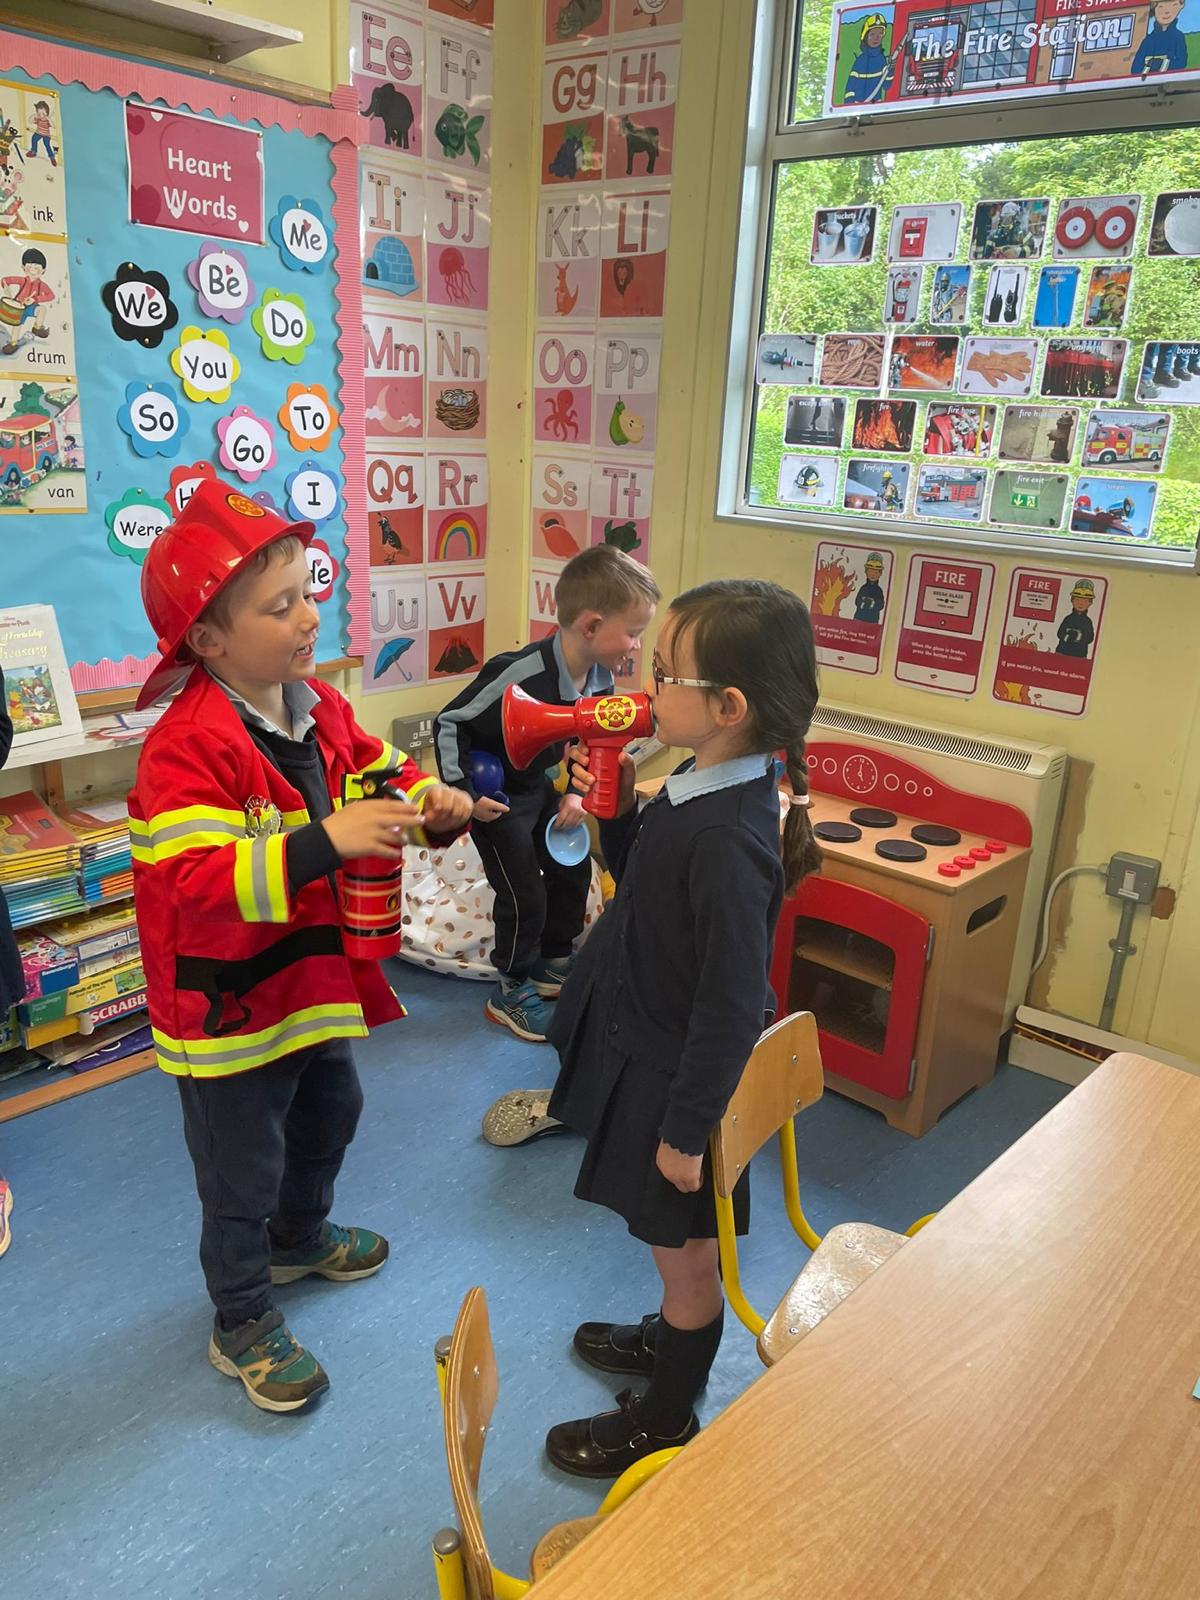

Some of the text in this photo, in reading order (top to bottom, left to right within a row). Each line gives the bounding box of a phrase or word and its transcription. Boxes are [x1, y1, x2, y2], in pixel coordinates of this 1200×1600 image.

[362, 11, 413, 80] Ee
[912, 14, 1121, 62] The Fire Station
[440, 37, 480, 100] Ff
[618, 52, 667, 106] Hh
[552, 64, 598, 113] Gg
[167, 147, 232, 182] Heart
[33, 206, 54, 222] ink
[163, 185, 237, 221] Words
[437, 190, 476, 243] Jj
[289, 222, 323, 251] Me
[545, 205, 591, 257] Kk
[208, 264, 242, 297] Be
[117, 290, 163, 320] We
[271, 308, 304, 338] Do
[27, 348, 66, 364] drum
[362, 324, 420, 372] Mm
[437, 329, 480, 378] Nn
[915, 340, 936, 348] water
[1176, 346, 1199, 355] boots
[184, 356, 228, 379] You
[539, 338, 588, 385] Oo
[605, 340, 649, 390] Pp
[138, 404, 175, 432] So
[293, 406, 325, 431] To
[1018, 409, 1033, 418] fire
[233, 434, 265, 463] Go
[48, 488, 74, 499] van
[307, 481, 321, 506] I
[367, 459, 418, 504] Qq
[438, 460, 478, 506] Rr
[542, 464, 578, 507] Ss
[602, 467, 642, 518] Tt
[1016, 475, 1030, 484] fire
[120, 521, 163, 537] Were
[935, 570, 967, 586] FIRE
[1028, 579, 1051, 591] FIRE
[372, 588, 419, 633] Uu
[438, 581, 477, 622] Vv
